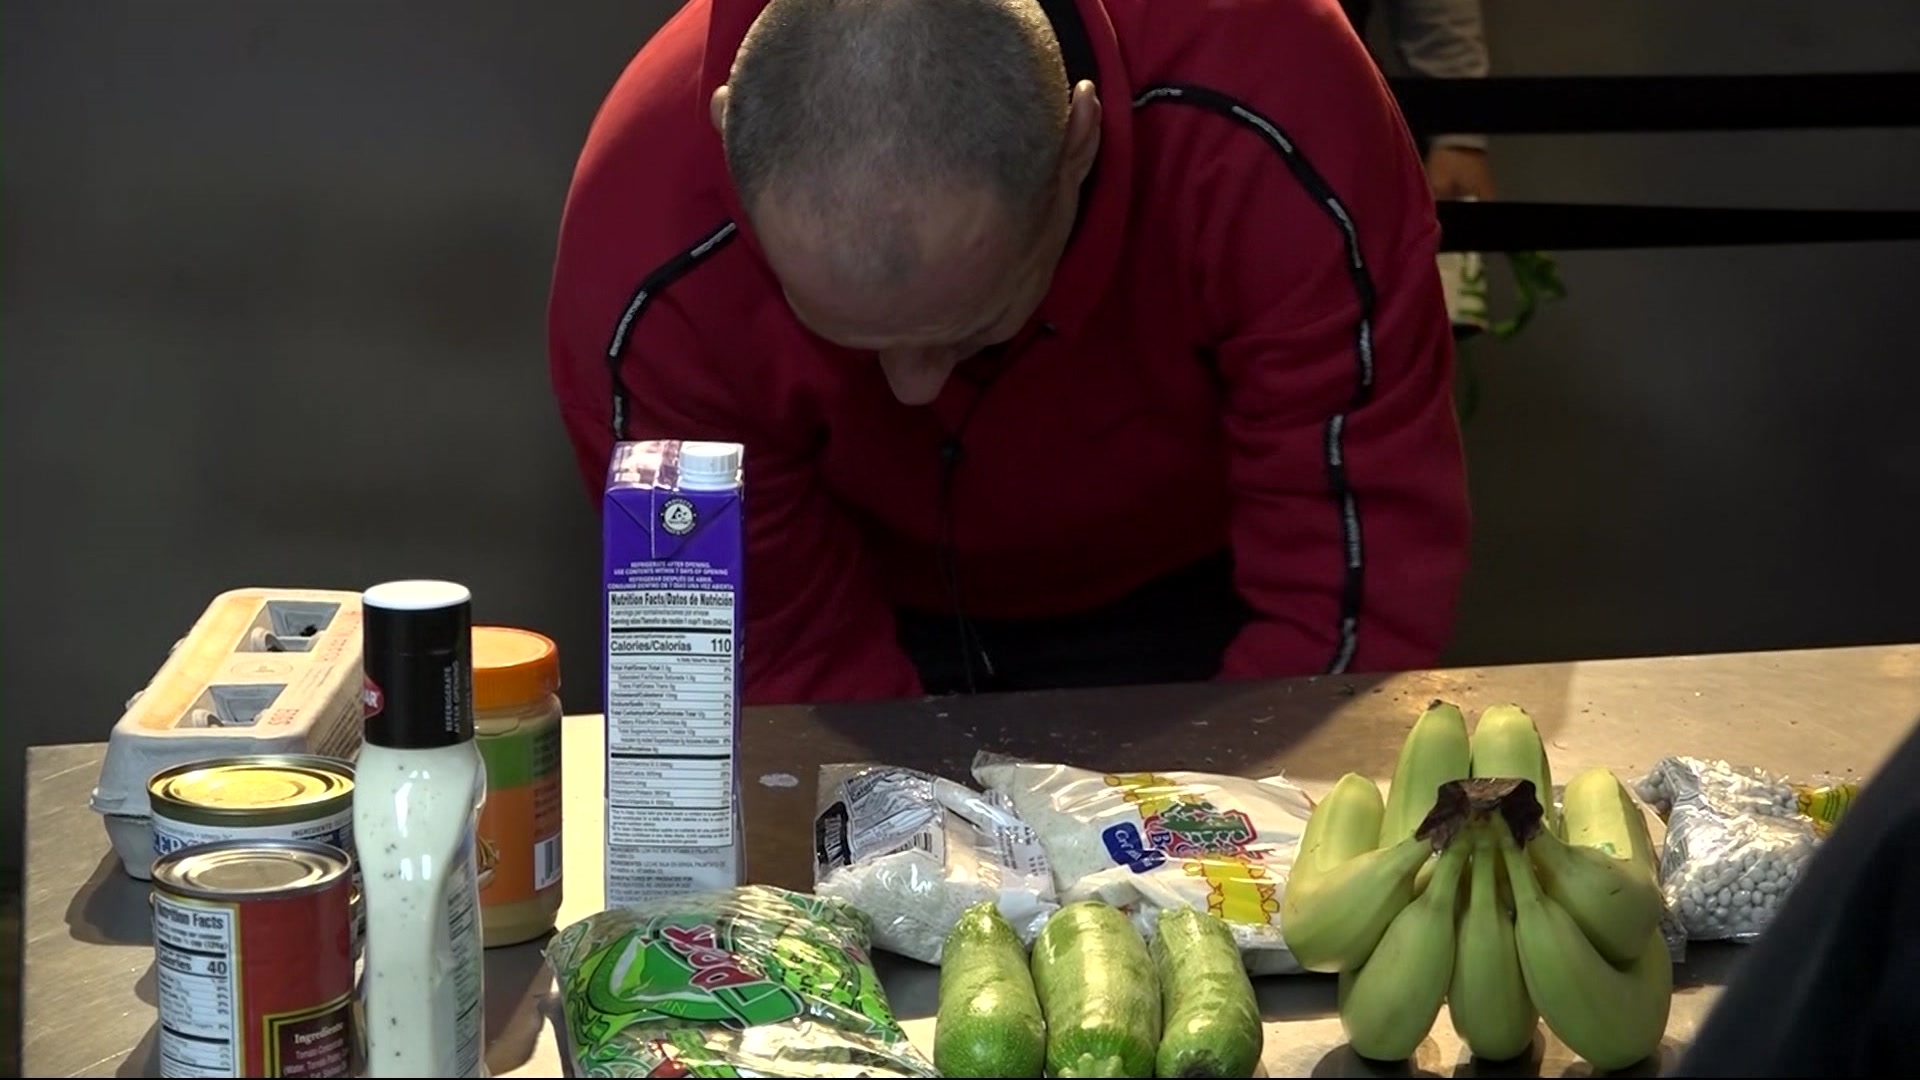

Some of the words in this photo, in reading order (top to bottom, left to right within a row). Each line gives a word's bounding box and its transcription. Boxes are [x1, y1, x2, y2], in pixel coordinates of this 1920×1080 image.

[613, 568, 625, 576] USE
[625, 568, 654, 576] CONTENTS
[610, 593, 643, 606] Nutrition
[644, 592, 688, 606] Facts/Datos
[689, 593, 699, 606] de
[710, 638, 732, 652] 110
[443, 665, 453, 732] REFRIGERATE
[192, 913, 225, 930] Facts
[207, 960, 228, 975] 40
